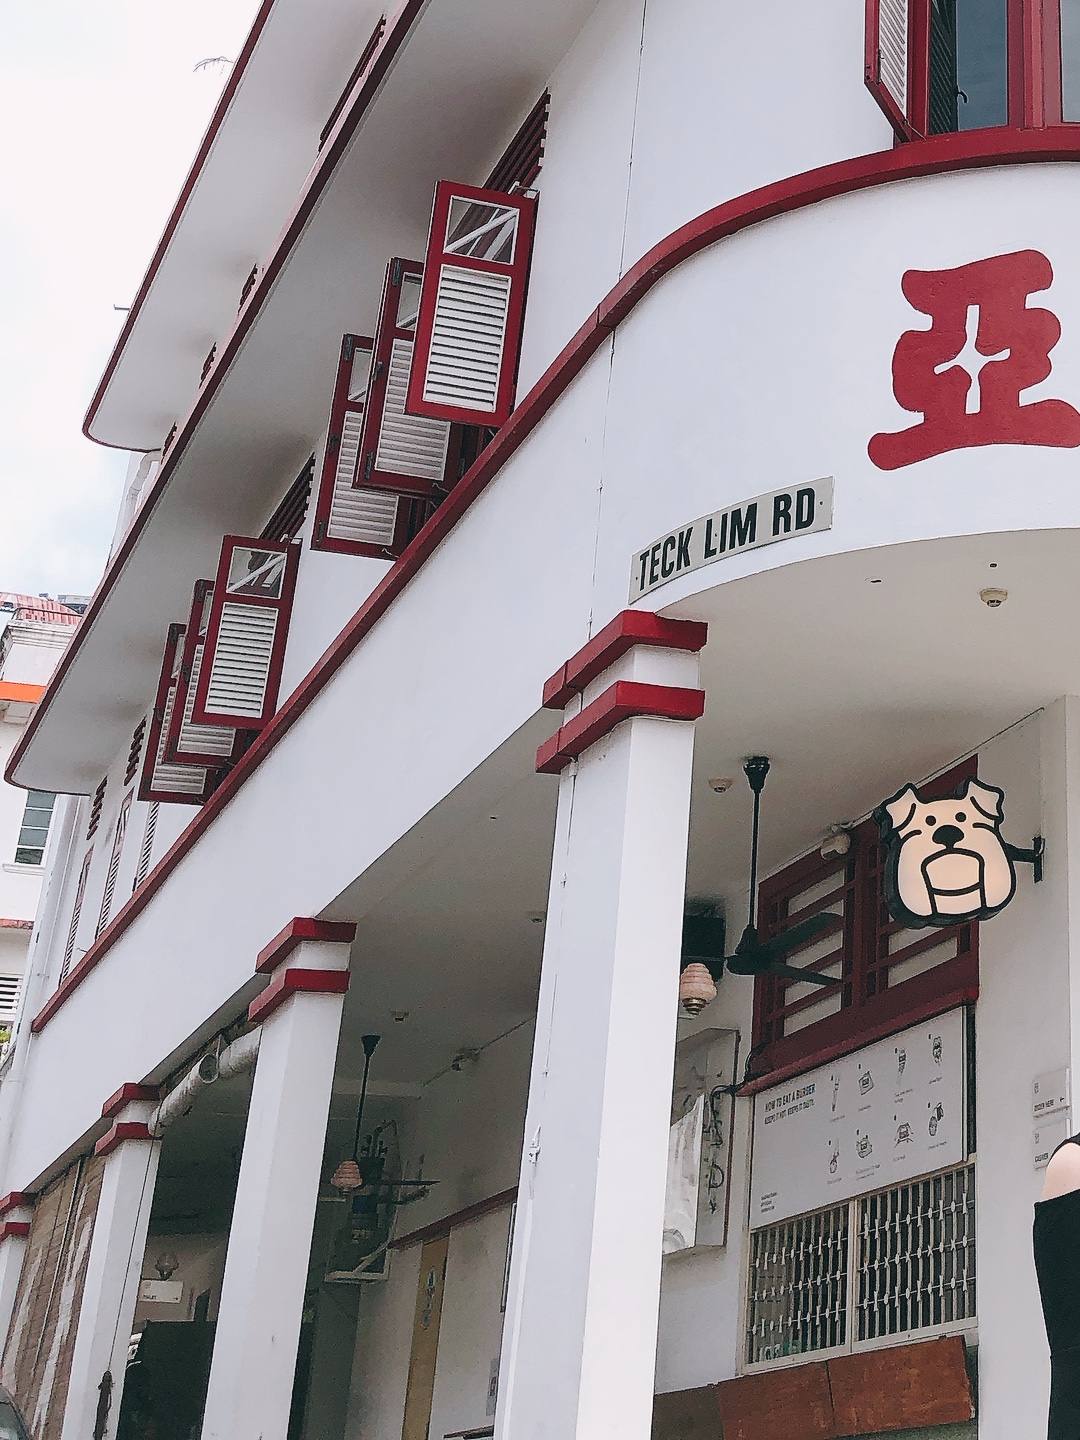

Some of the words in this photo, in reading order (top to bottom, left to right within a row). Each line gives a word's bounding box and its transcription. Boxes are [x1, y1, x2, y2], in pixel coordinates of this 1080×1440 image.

[639, 526, 693, 591] TECK
[704, 502, 758, 559] LIM
[772, 487, 815, 536] RD
[783, 1093, 792, 1106] EAT
